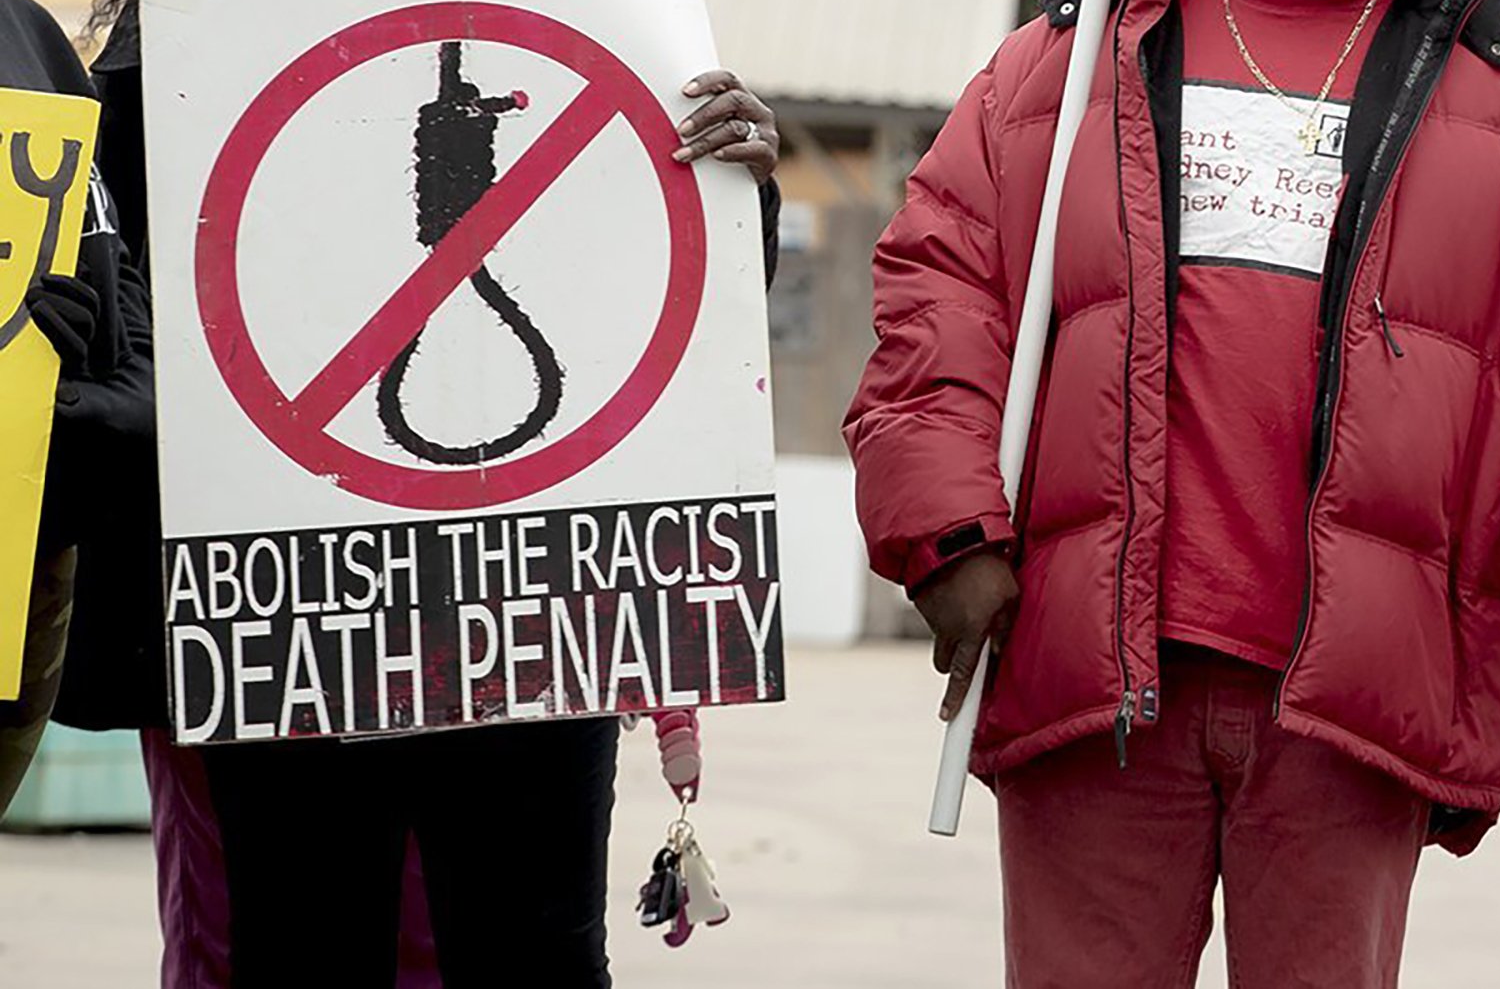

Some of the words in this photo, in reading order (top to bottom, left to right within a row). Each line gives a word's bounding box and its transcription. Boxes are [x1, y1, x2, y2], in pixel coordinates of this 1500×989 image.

[1249, 195, 1337, 232] tria
[167, 527, 420, 623] ABOLISH
[437, 515, 550, 603] THE
[569, 500, 777, 593] RACIST
[172, 608, 425, 744] DEATH
[457, 581, 781, 723] PENALTY
